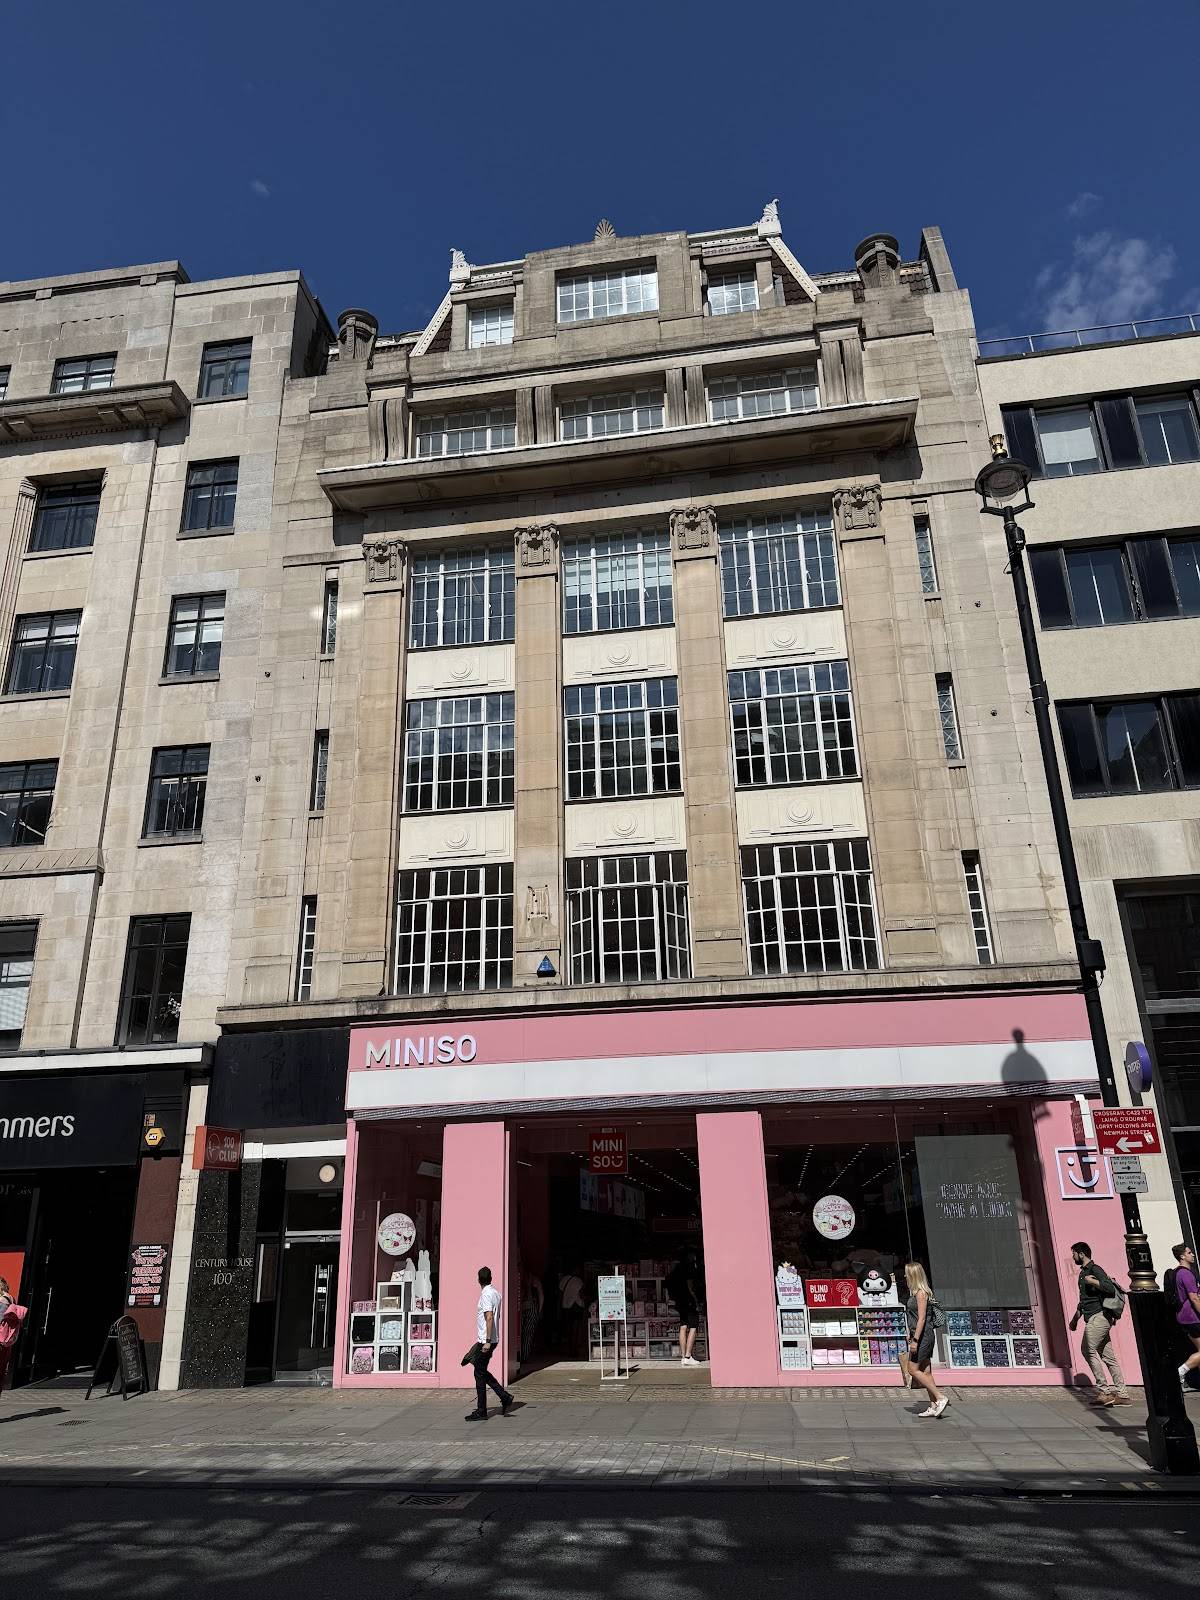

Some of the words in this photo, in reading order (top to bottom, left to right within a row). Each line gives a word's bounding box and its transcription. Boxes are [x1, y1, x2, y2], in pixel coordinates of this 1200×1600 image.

[365, 1034, 477, 1068] MINISO
[223, 1136, 235, 1149] 100
[592, 1139, 623, 1152] MINI
[219, 1150, 238, 1163] CLUB
[195, 1258, 228, 1268] CENTURY
[213, 1272, 232, 1285] 100
[809, 1284, 829, 1294] BLIND
[813, 1293, 827, 1303] BOX
